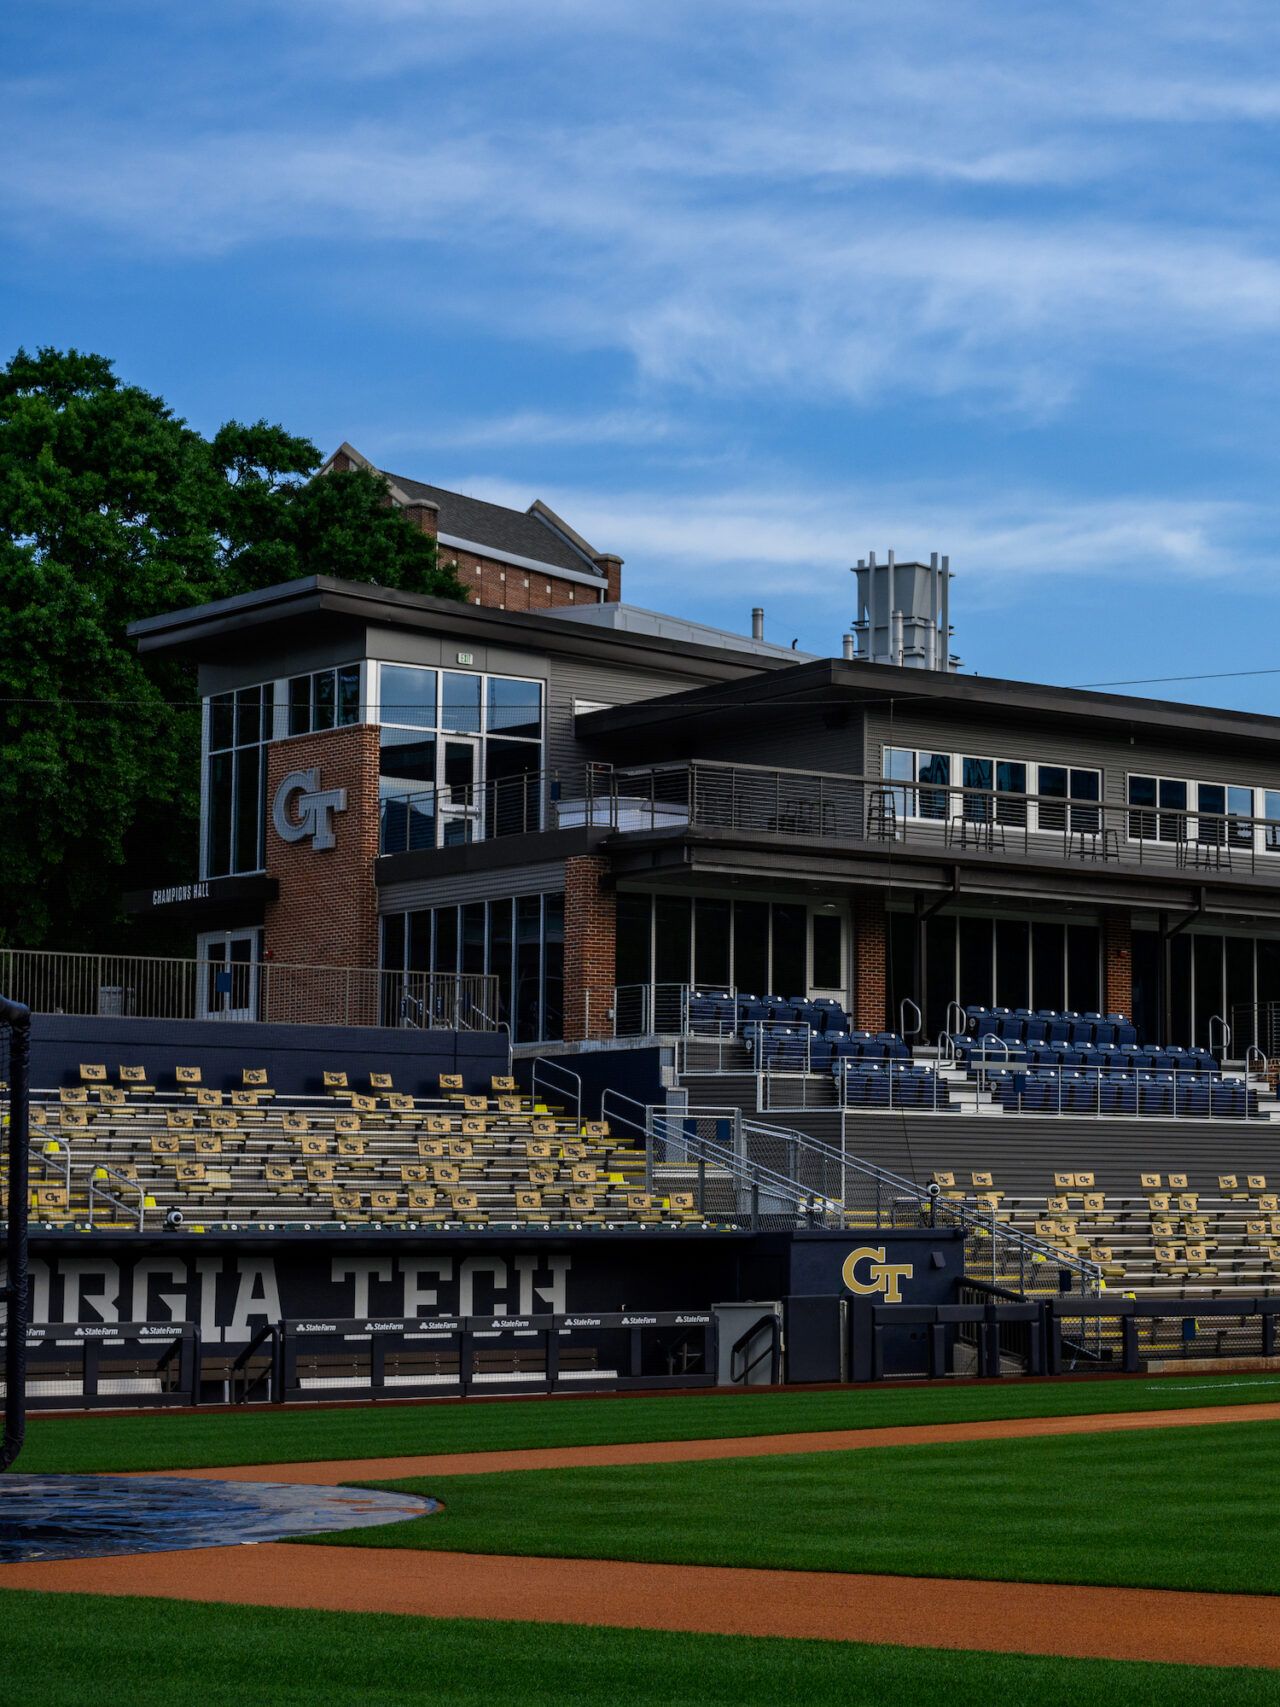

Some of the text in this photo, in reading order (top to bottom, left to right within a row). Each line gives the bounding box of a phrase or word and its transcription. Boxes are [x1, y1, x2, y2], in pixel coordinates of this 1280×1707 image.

[273, 768, 347, 850] GT
[153, 882, 209, 905] CHAMPIONS HALL
[331, 1255, 573, 1341] TECH
[842, 1246, 913, 1303] GT
